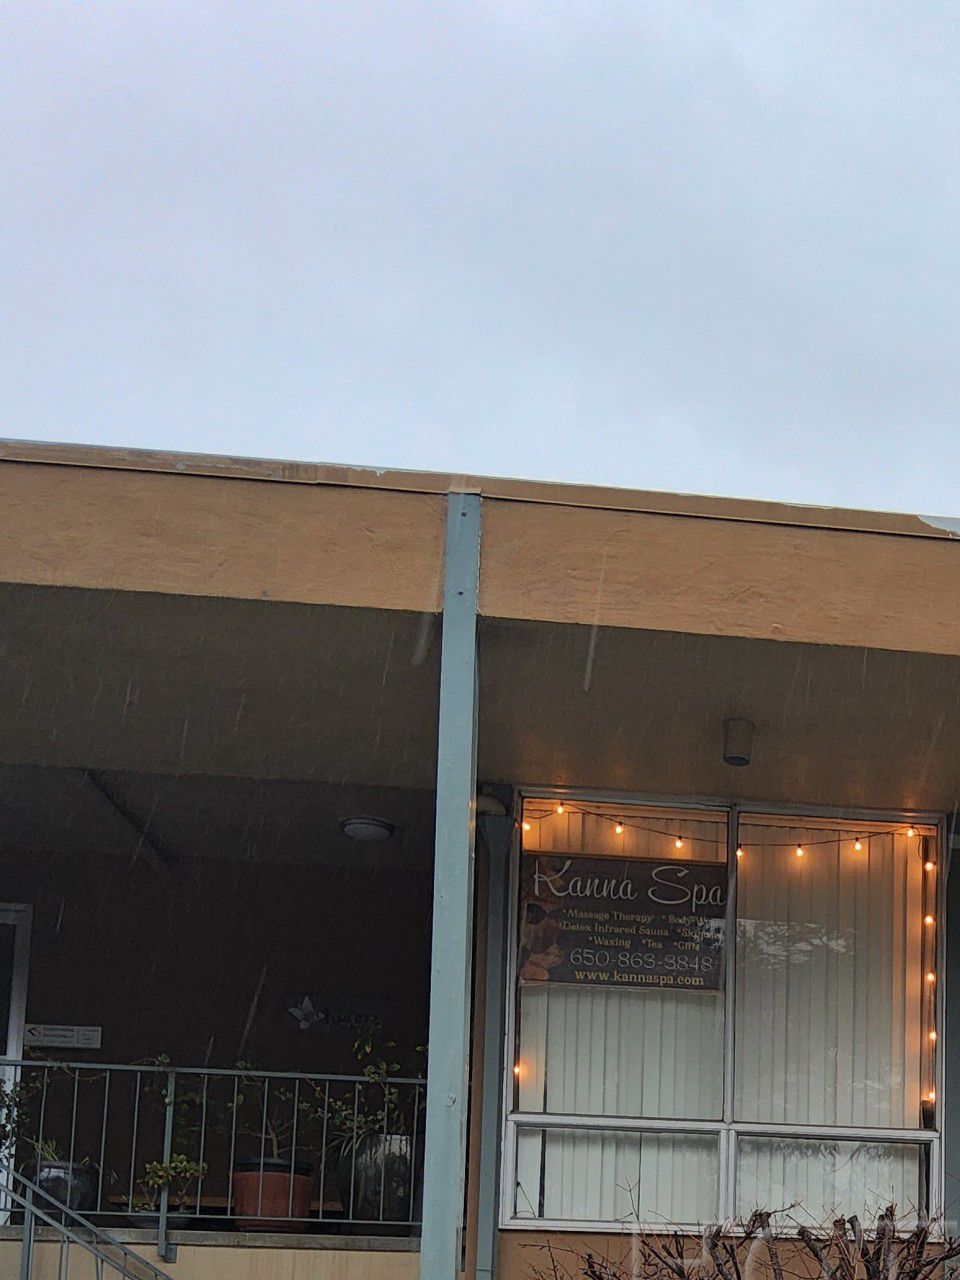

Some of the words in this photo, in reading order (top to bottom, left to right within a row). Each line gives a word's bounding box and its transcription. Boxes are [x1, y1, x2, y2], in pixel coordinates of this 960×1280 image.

[533, 859, 638, 900] Kanna
[647, 865, 726, 912] Spa
[594, 923, 636, 934] Infrared
[638, 926, 669, 937] Sauna
[570, 948, 713, 972] 650-863-3848
[574, 969, 704, 987] www.kannaspa.com
